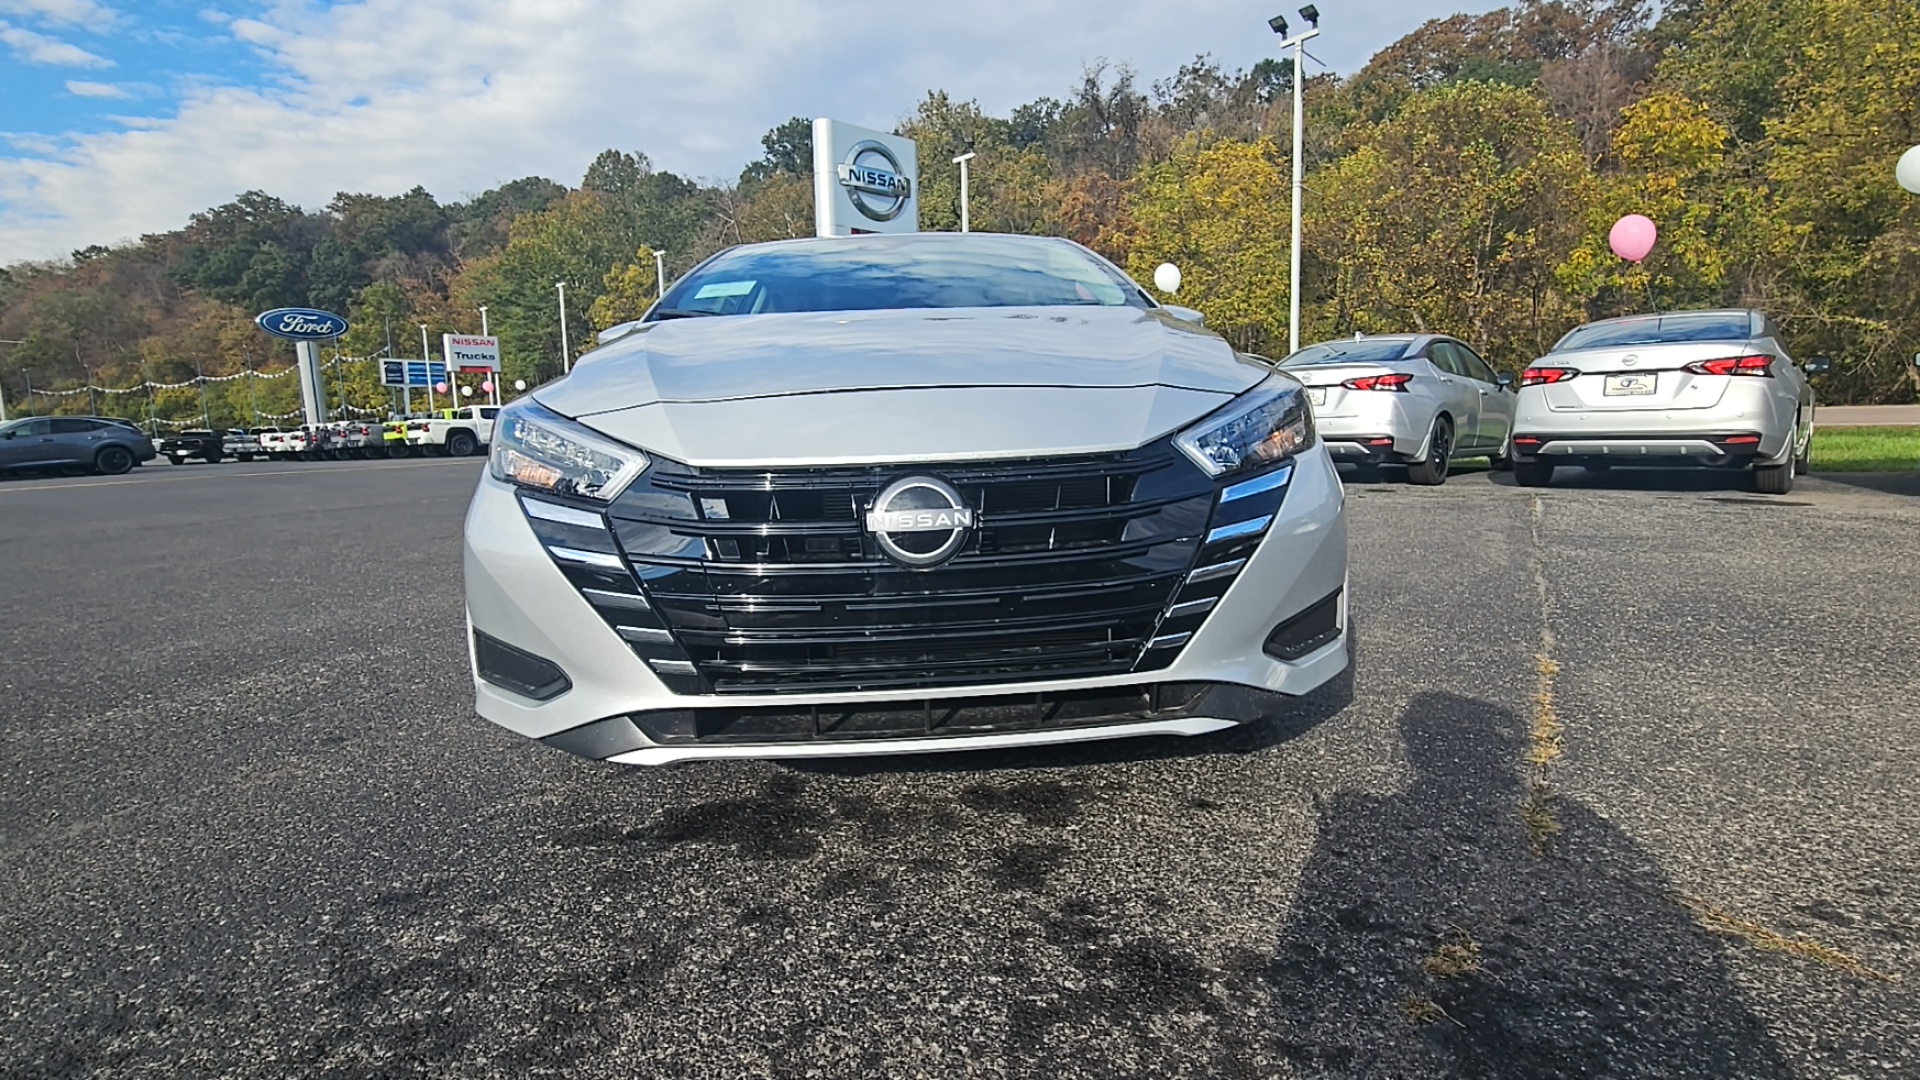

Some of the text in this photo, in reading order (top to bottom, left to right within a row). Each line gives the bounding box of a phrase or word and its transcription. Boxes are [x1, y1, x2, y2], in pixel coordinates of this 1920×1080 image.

[848, 169, 906, 191] NISSAN
[279, 313, 333, 333] Ford
[452, 337, 495, 347] NISSAN
[454, 351, 496, 361] Trucks
[870, 511, 969, 528] NISSAN
